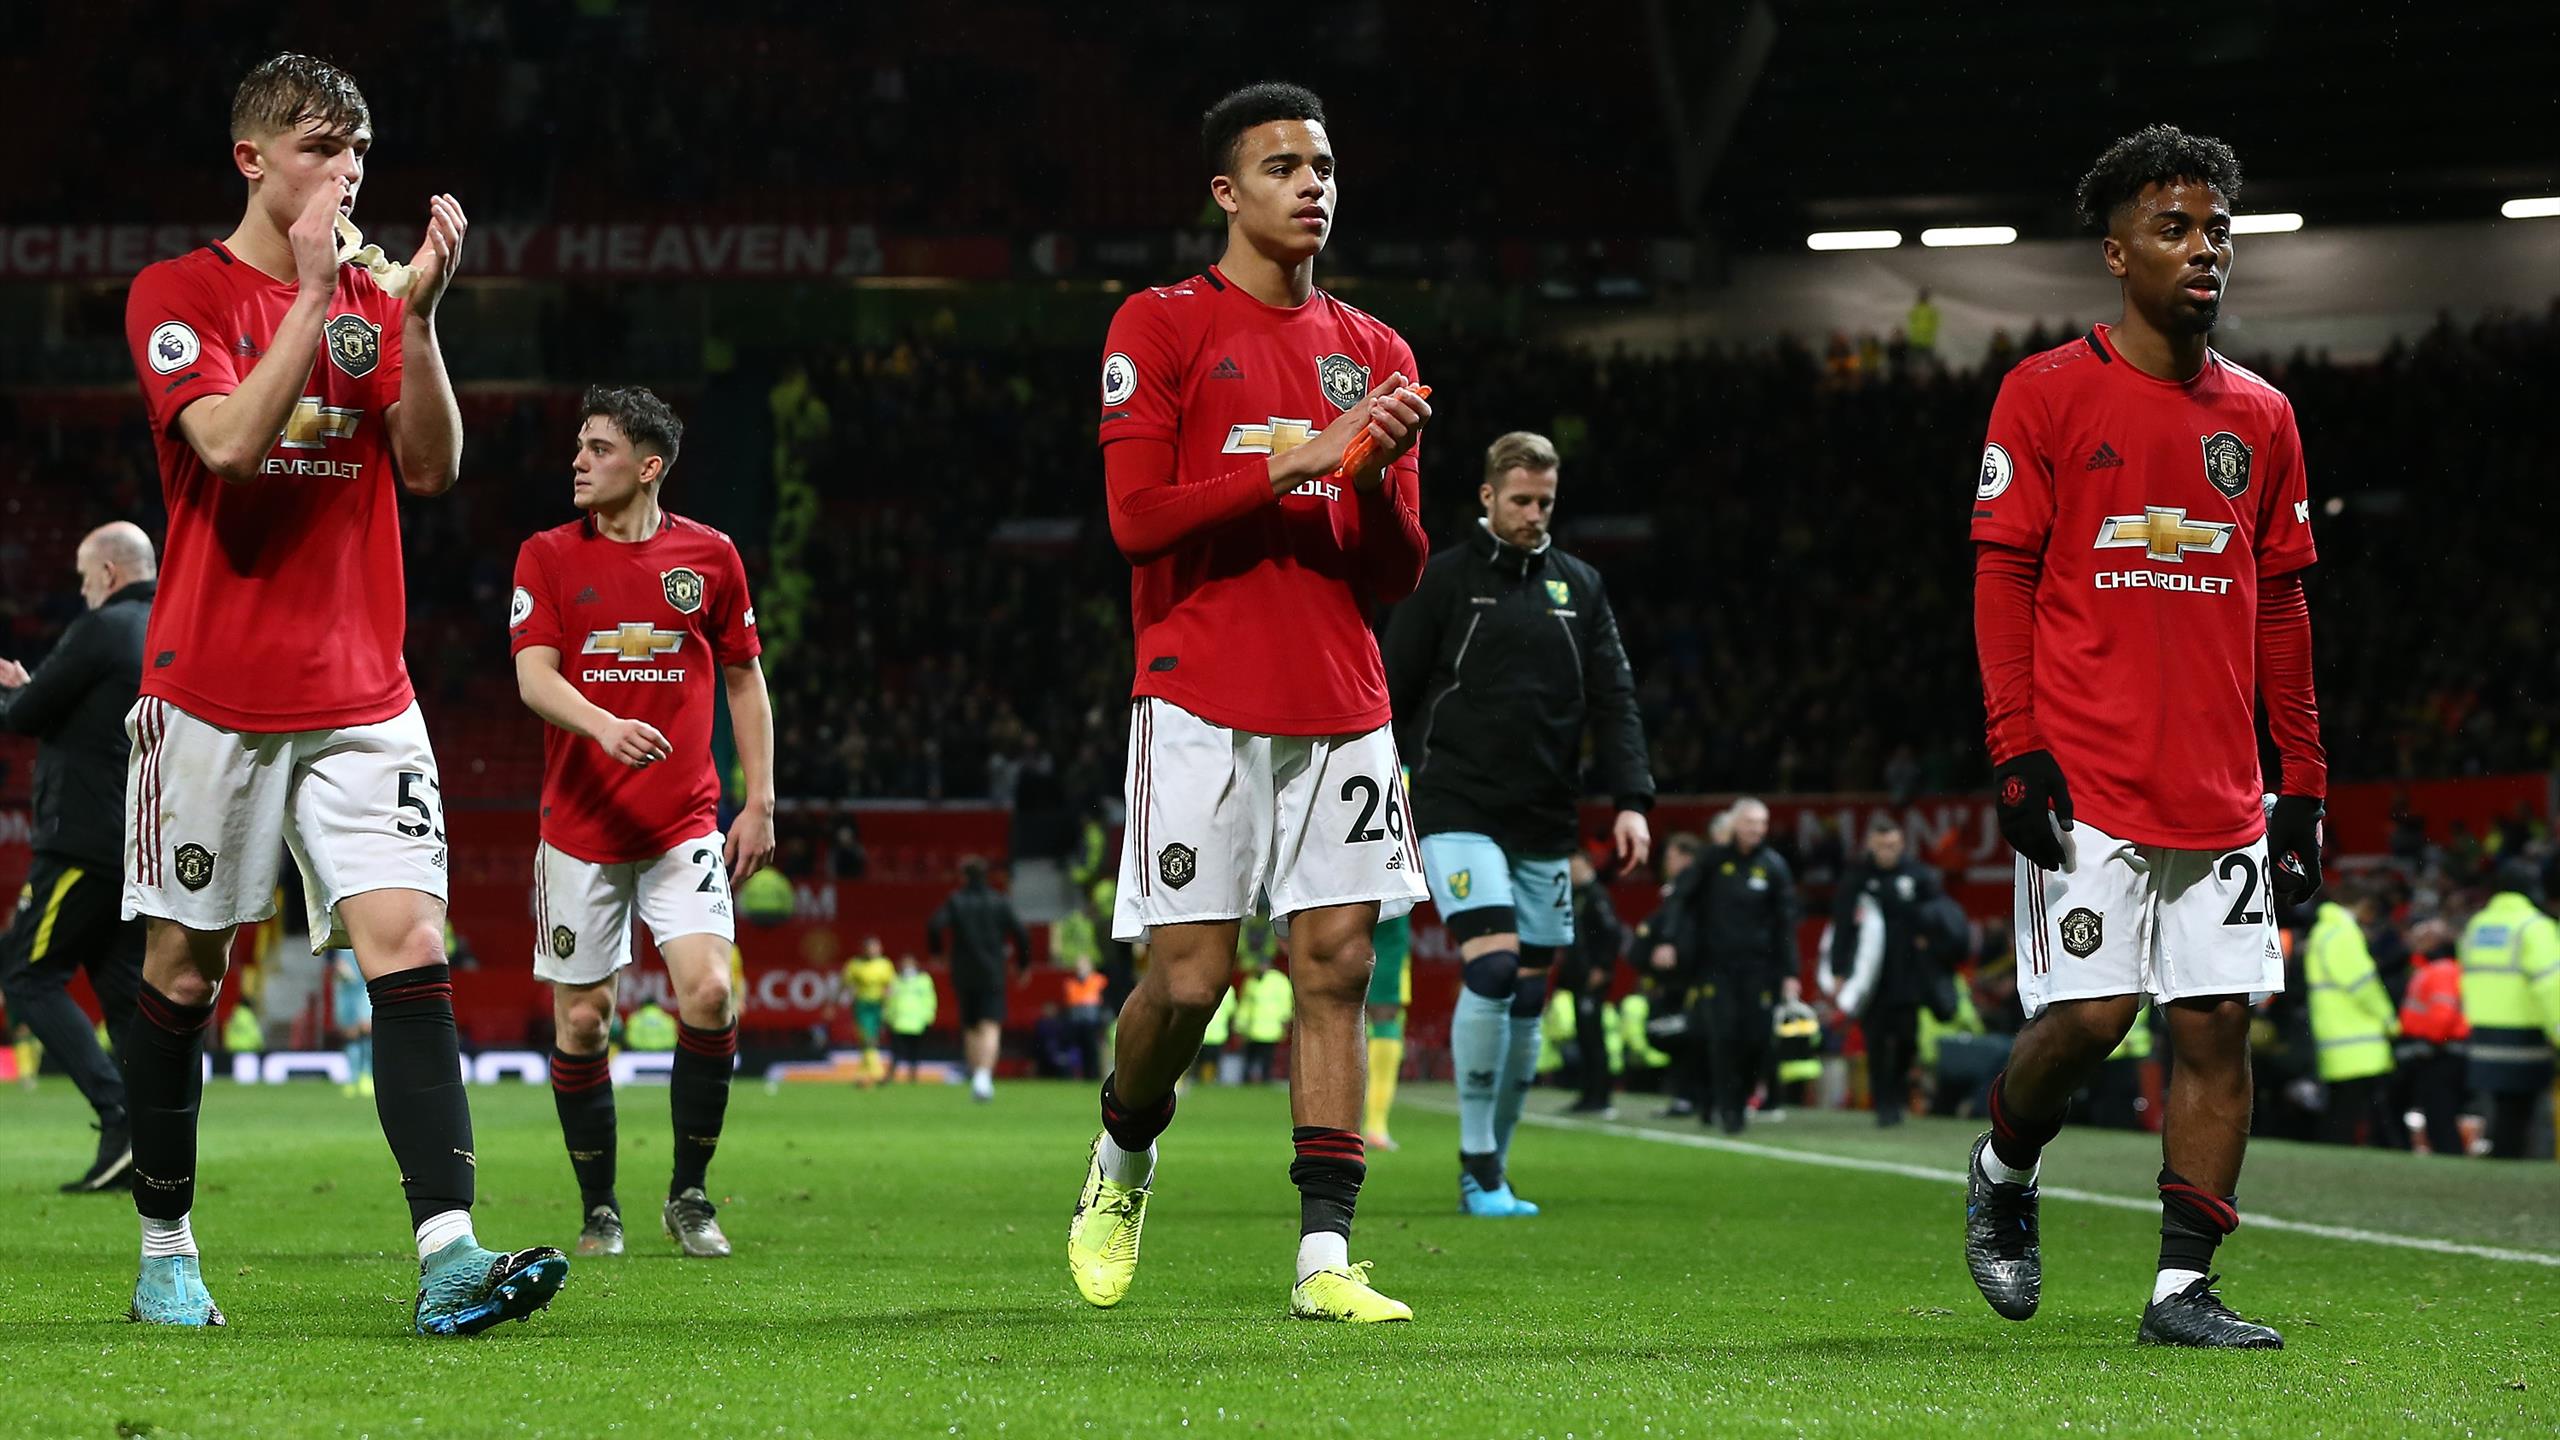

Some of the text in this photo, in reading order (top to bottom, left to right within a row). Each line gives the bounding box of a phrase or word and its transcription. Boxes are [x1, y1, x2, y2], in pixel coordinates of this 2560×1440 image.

[556, 226, 829, 272] HEAVEN
[1290, 480, 1342, 502] OLET
[2095, 570, 2233, 594] CHEVROLET
[582, 669, 685, 682] CHEVROLET
[1340, 774, 1404, 844] 26
[2219, 852, 2274, 928] 28
